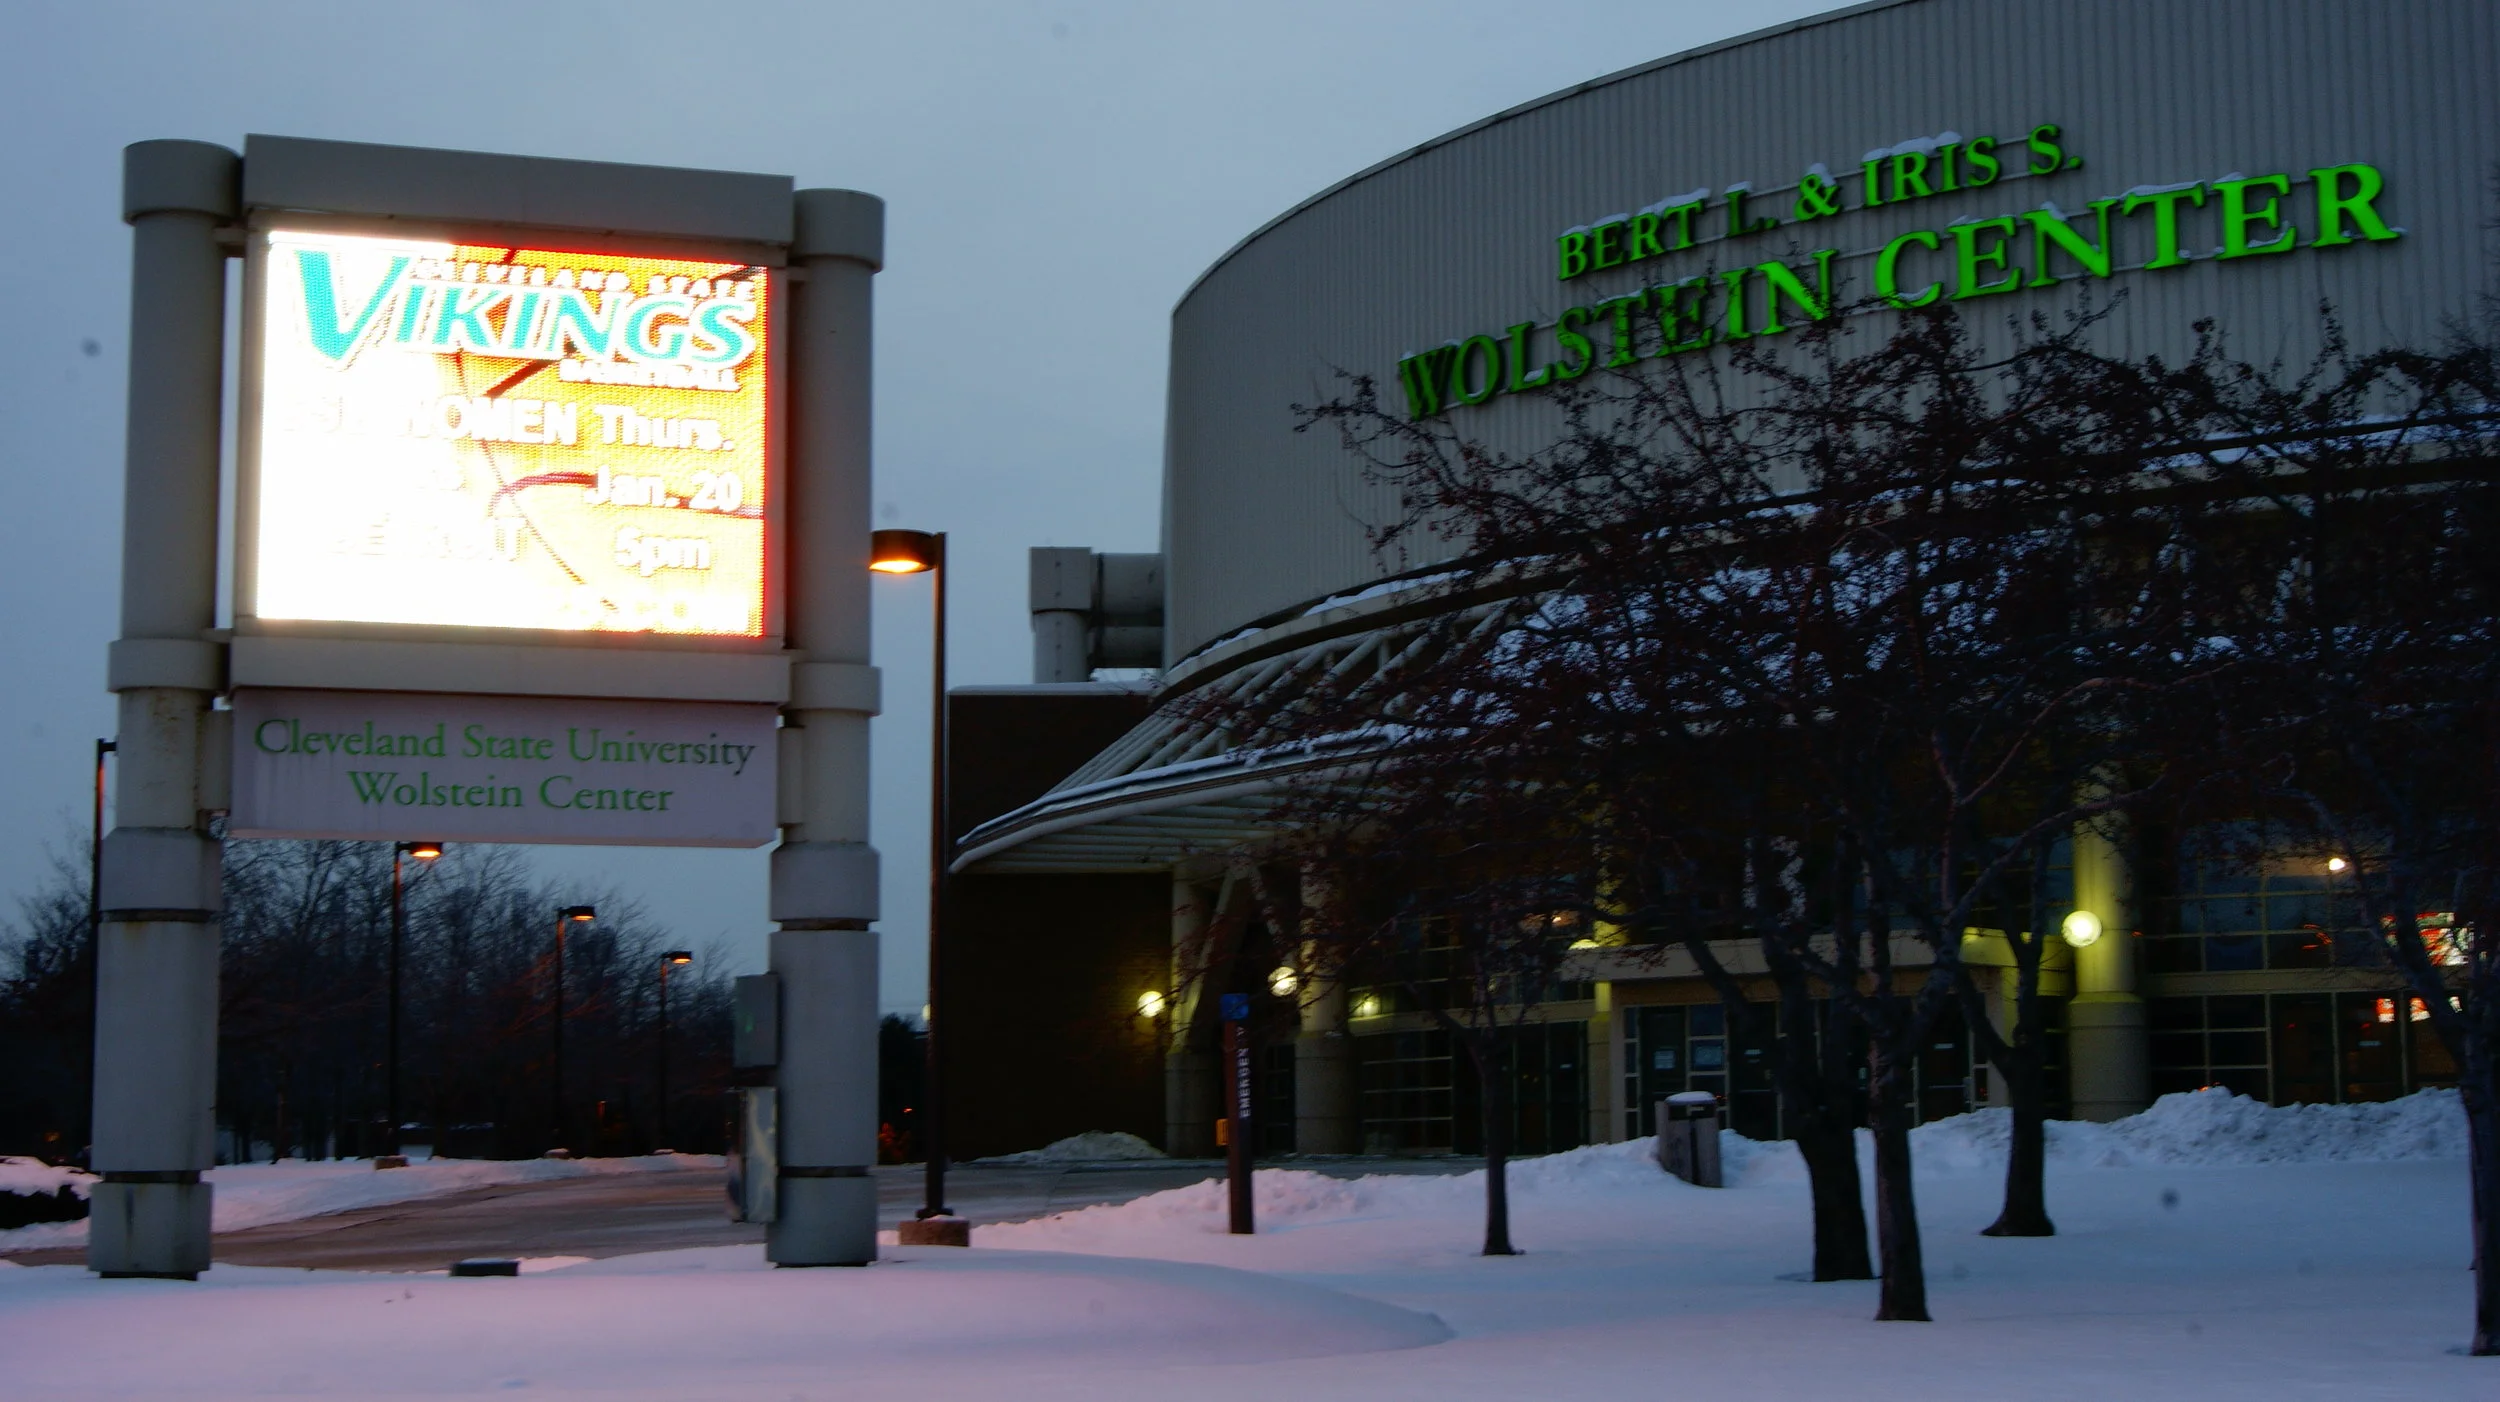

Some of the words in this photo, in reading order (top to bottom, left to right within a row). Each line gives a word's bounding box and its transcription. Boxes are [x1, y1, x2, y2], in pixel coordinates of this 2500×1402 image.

[1557, 199, 1705, 281] BERT
[1725, 189, 1779, 238] L.
[1793, 172, 1842, 222] &
[1860, 136, 2001, 208] IRIS
[2026, 122, 2083, 176] S.
[294, 249, 755, 366] VIKINGS
[1398, 247, 1840, 420] WOLSTEIN
[1872, 162, 2402, 312] CENTER
[595, 405, 734, 451] Thurs.
[585, 466, 678, 509] Jan.
[690, 471, 743, 512] 20
[615, 528, 711, 576] 5pm
[253, 718, 446, 757] Cleveland
[462, 726, 554, 761] State
[568, 728, 757, 775] University
[348, 771, 524, 808] Wolstein
[539, 775, 674, 812] Center
[1236, 1026, 1252, 1118] EMERGENY
